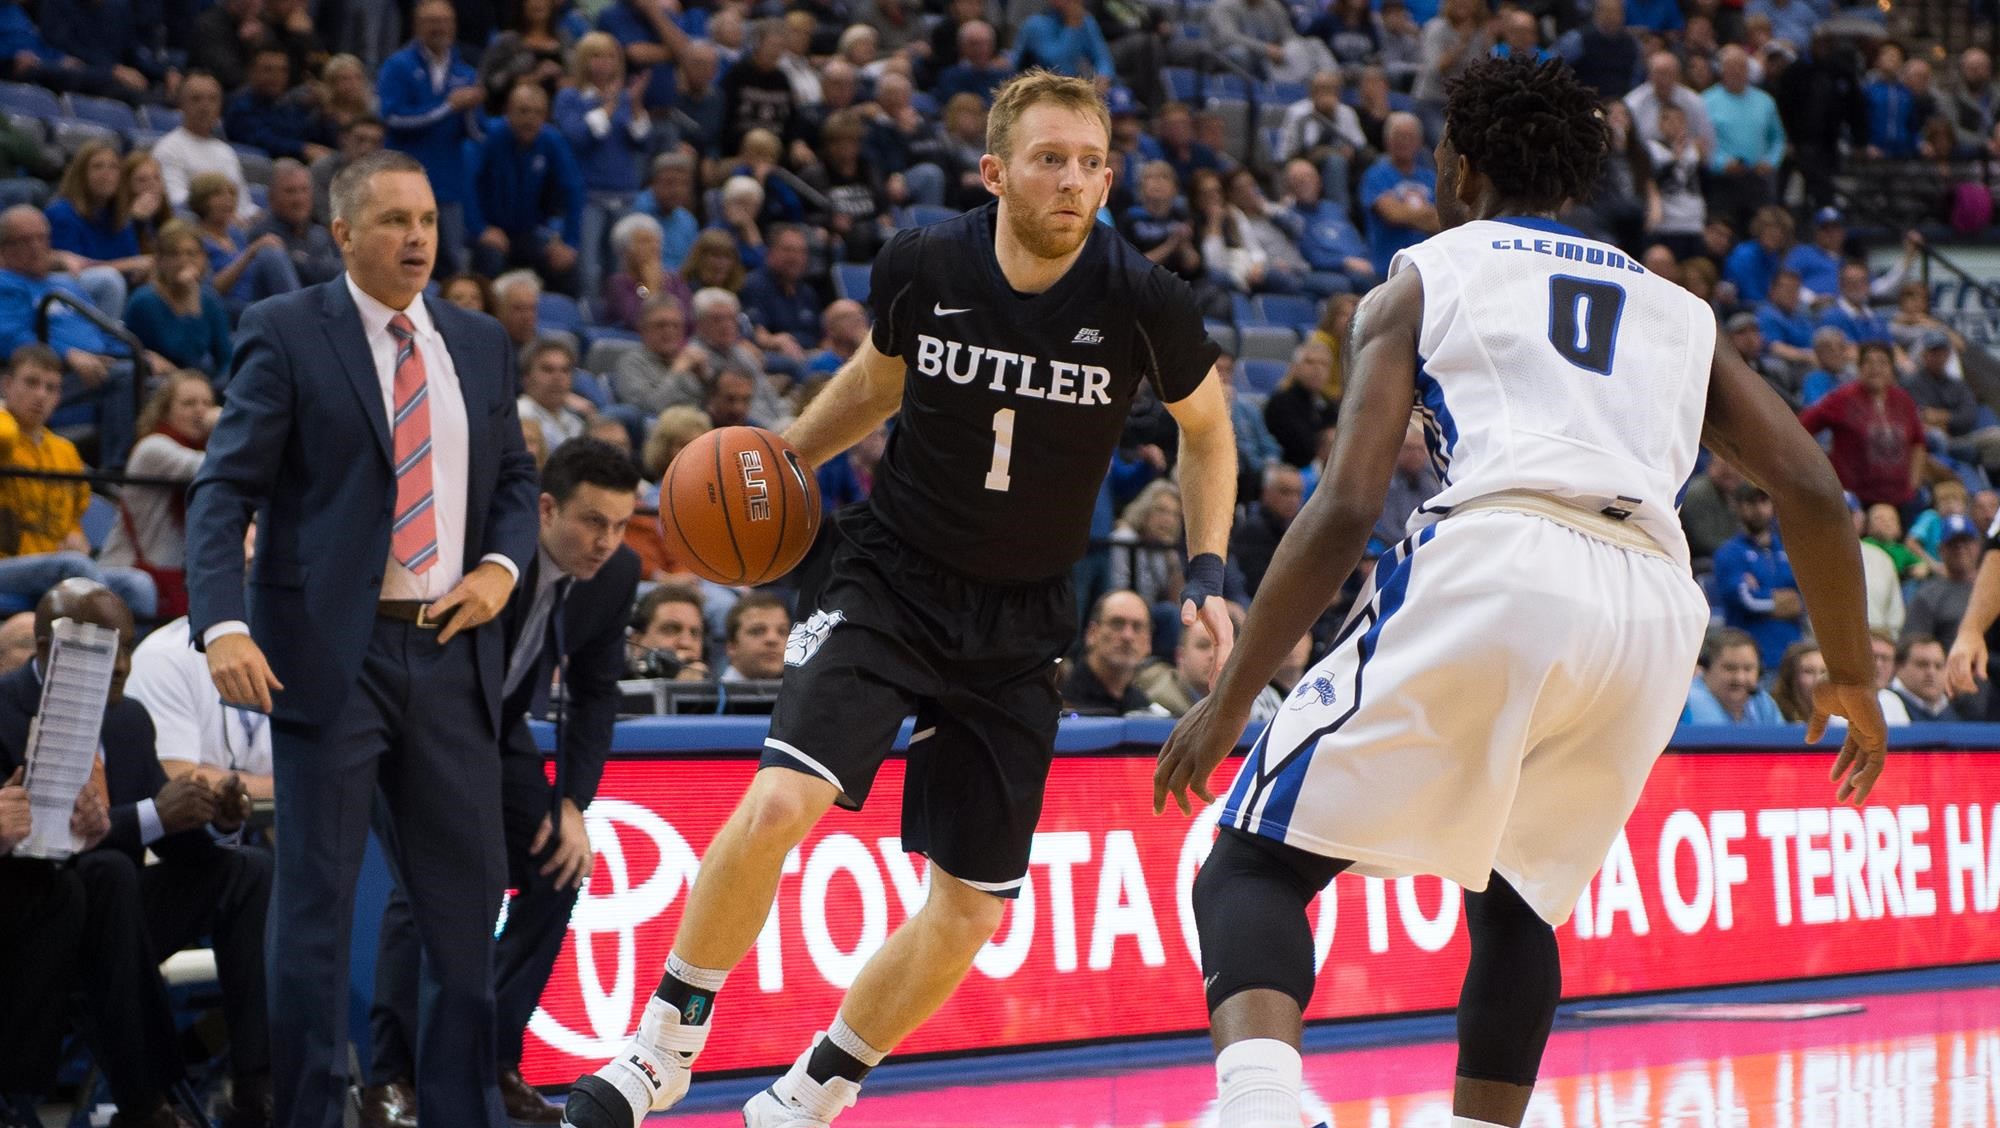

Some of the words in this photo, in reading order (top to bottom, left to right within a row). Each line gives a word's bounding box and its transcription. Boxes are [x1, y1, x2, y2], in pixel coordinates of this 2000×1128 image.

[1492, 239, 1645, 274] CLEMONS
[1074, 334, 1104, 343] EAST
[1079, 327, 1100, 336] BIG
[1548, 273, 1627, 376] 0
[917, 334, 1112, 405] BUTLER
[739, 449, 770, 522] ELITE
[984, 407, 1016, 492] 1
[1658, 808, 1748, 935] OF
[1757, 804, 1937, 926] TERRE
